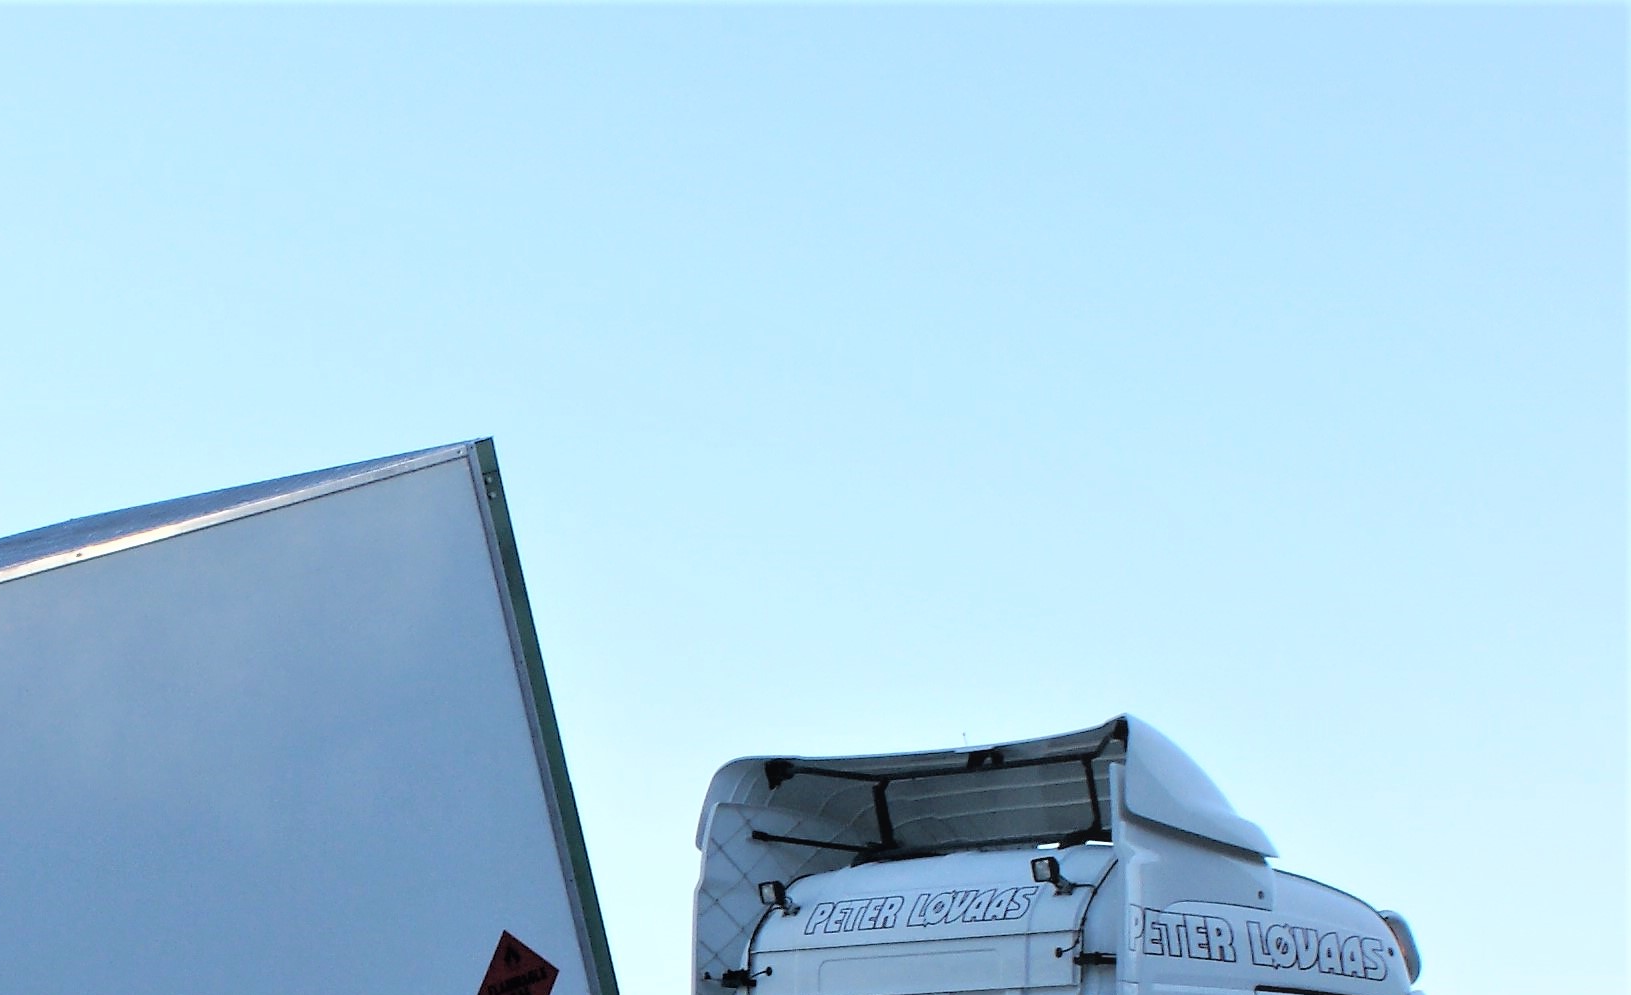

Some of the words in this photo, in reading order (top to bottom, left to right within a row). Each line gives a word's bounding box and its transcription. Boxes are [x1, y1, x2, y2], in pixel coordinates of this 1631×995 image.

[804, 896, 905, 935] PETER
[906, 886, 1039, 927] LØVAAS
[1128, 904, 1236, 962] PETER
[1245, 921, 1387, 981] LØVAAS
